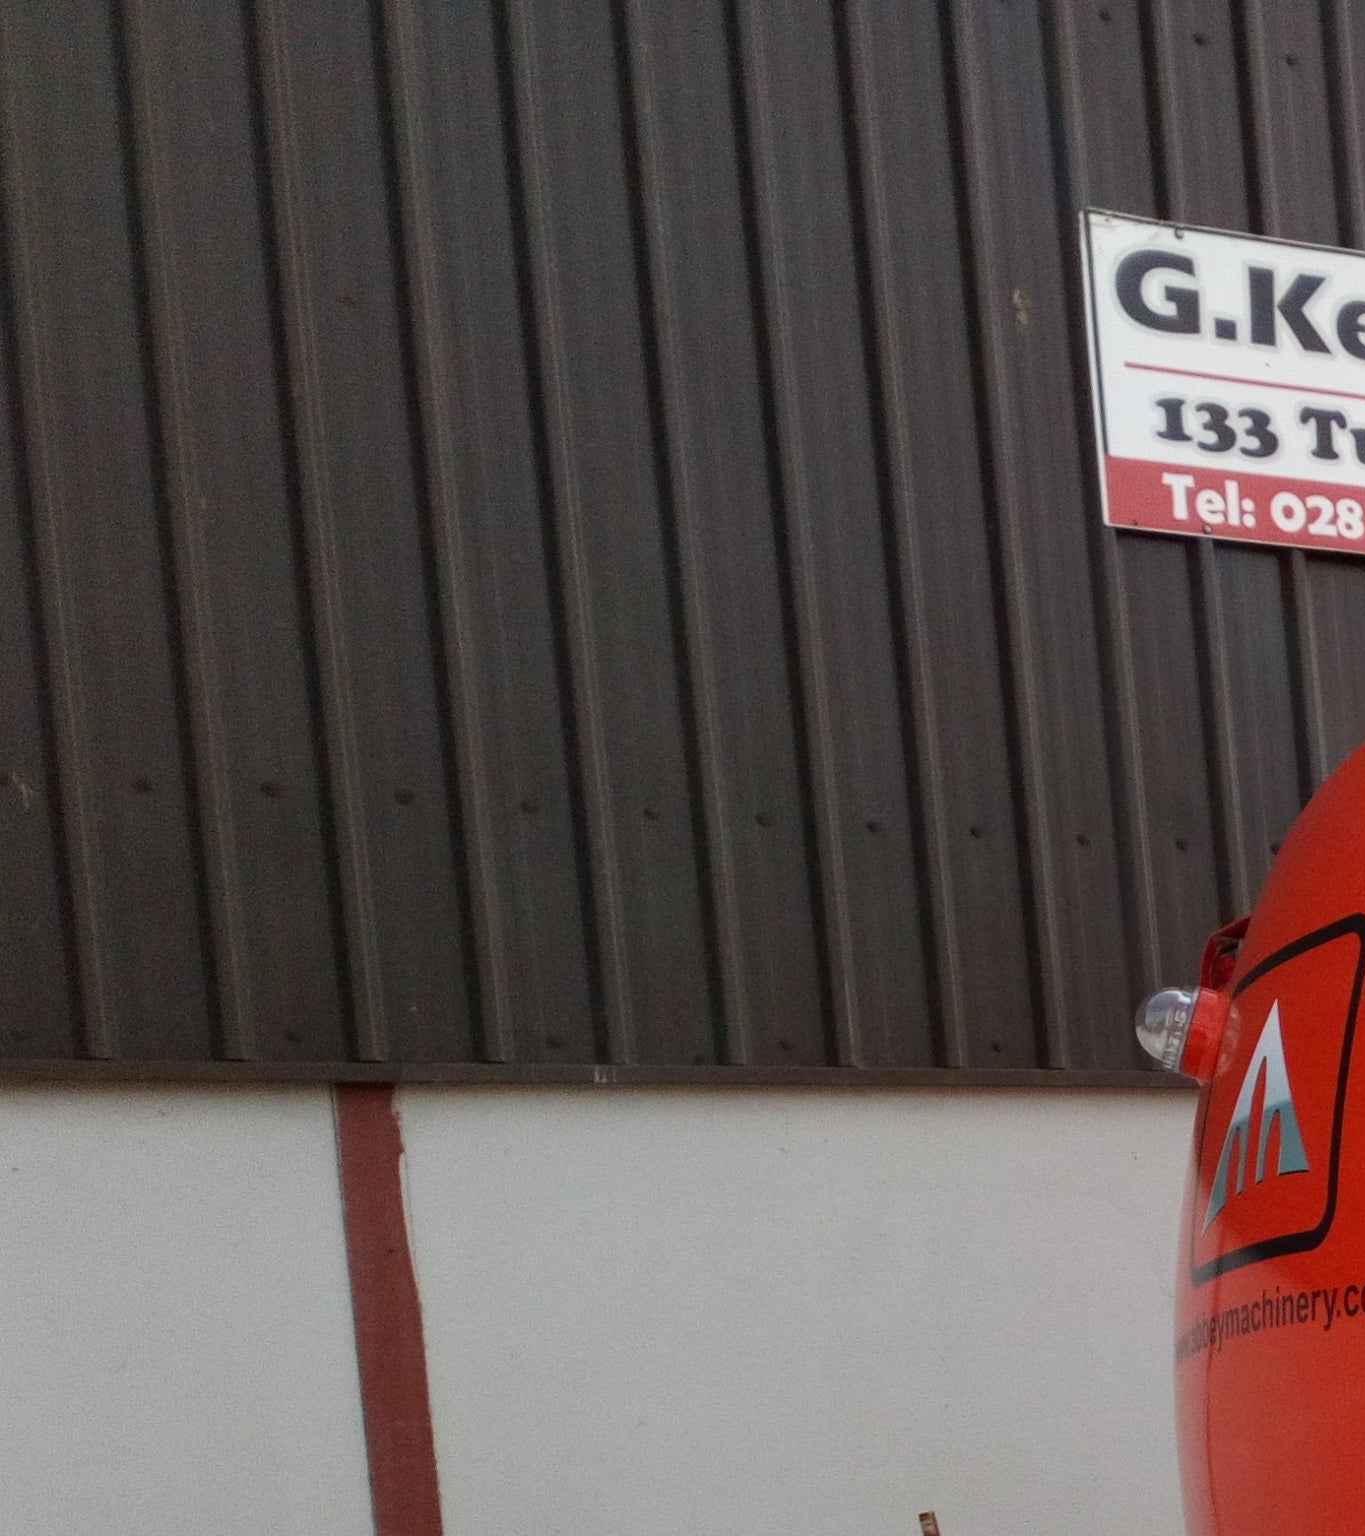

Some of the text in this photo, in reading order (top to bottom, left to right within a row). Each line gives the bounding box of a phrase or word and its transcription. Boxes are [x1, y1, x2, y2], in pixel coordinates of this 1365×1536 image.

[1156, 397, 1279, 459] 133
[1161, 472, 1257, 529] Tel:
[1270, 492, 1365, 541] 028
